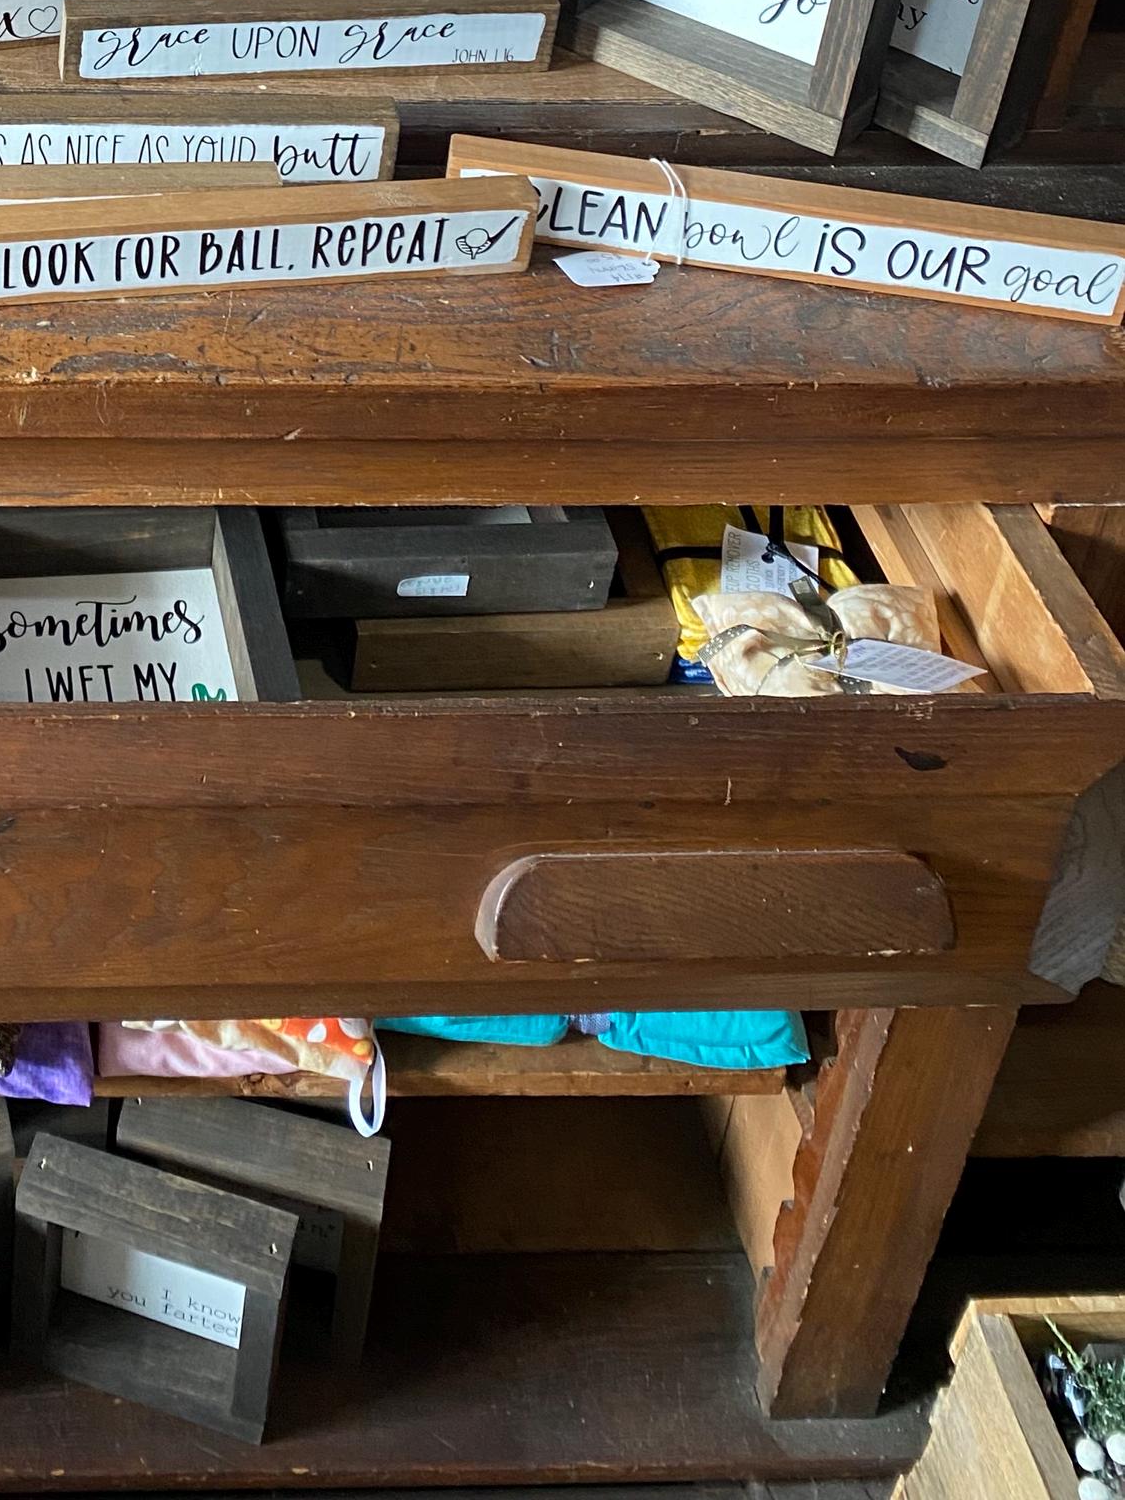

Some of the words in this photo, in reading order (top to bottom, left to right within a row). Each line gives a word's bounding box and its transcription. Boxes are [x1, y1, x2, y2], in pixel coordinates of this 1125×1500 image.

[94, 26, 210, 70] grace
[231, 26, 320, 59] UPON
[345, 18, 456, 63] grace
[452, 48, 487, 63] JOHN
[22, 134, 53, 164] AS
[275, 135, 378, 179] butt
[2, 242, 95, 290] LOOK
[114, 237, 180, 281] FOR
[199, 229, 294, 273] BALL.
[537, 186, 667, 241] LEAN
[685, 210, 799, 258] bowl
[889, 240, 989, 290] OUR
[1005, 256, 1114, 303] goal
[25, 668, 33, 701] I
[135, 663, 177, 701] MY
[107, 1286, 146, 1308] you
[162, 1303, 239, 1339] farted
[187, 1297, 241, 1324] know
